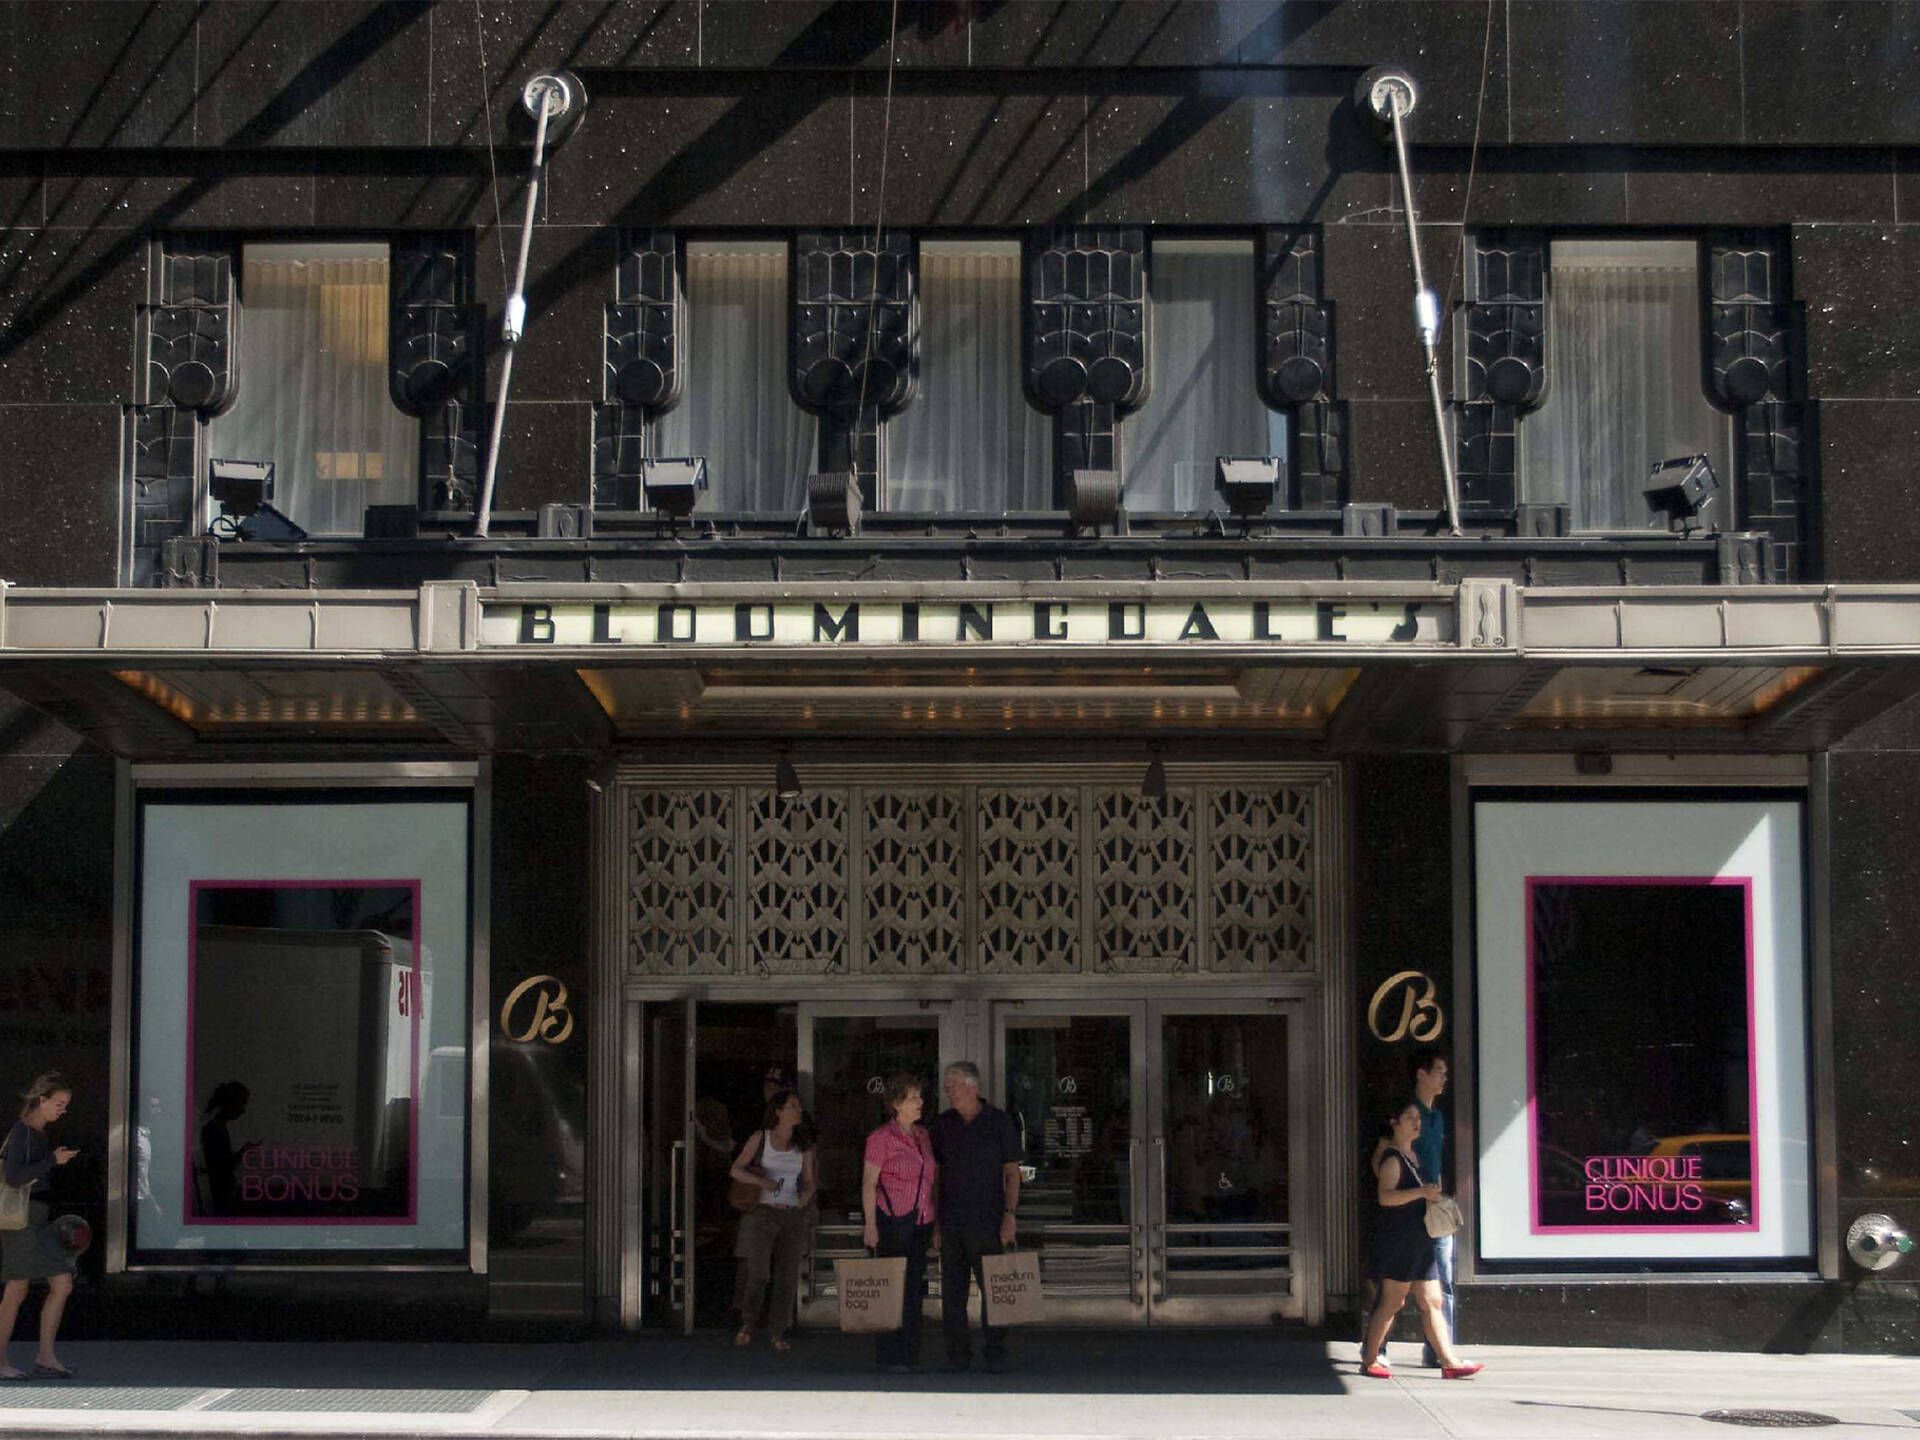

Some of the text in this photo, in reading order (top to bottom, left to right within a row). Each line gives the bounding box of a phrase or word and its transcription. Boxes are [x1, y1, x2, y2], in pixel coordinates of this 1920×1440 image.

[518, 601, 1422, 643] BLOOMINGDALE'S
[242, 1146, 361, 1170] CLINIQUE
[1584, 1157, 1703, 1182] CLINIQUE
[242, 1174, 361, 1201] BONUS
[1585, 1183, 1704, 1211] BONUS
[845, 1276, 889, 1288] medium
[990, 1270, 1035, 1283] medium
[845, 1287, 880, 1298] brown
[991, 1283, 1027, 1294] brown
[845, 1299, 870, 1312] bag
[991, 1294, 1017, 1306] bag
